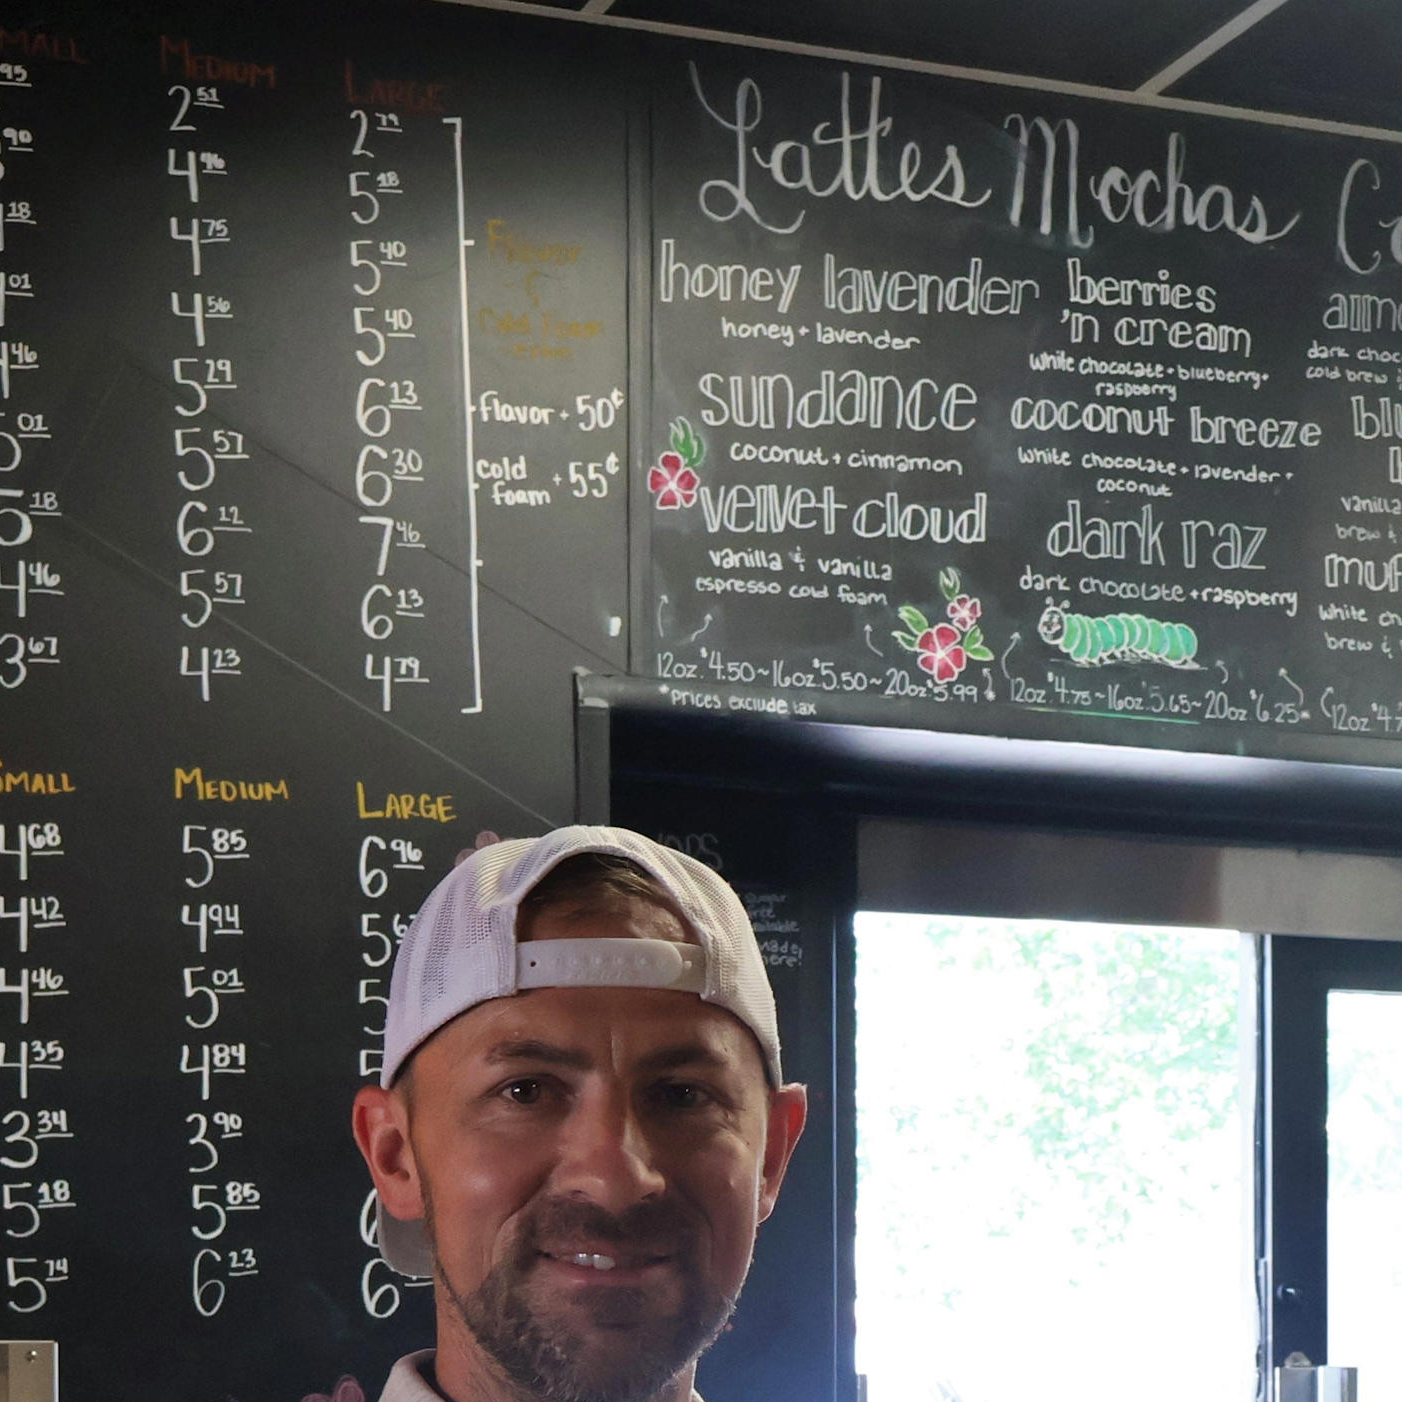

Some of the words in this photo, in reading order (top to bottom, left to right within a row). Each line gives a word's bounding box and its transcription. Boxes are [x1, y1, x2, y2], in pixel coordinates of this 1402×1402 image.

[688, 60, 992, 234] Lattes
[1004, 113, 1300, 249] Mochas
[660, 238, 802, 313] honey
[824, 252, 1040, 315] lavender
[1067, 258, 1217, 314] berries
[721, 316, 794, 347] honey
[816, 320, 921, 351] lavender
[1114, 316, 1252, 358] cream
[1029, 351, 1075, 371] white
[1079, 356, 1164, 379] chocolate
[699, 370, 977, 431] sundance
[1096, 381, 1177, 402] raspberry
[1010, 397, 1176, 436] coconut
[1190, 406, 1322, 448] breeze
[476, 455, 527, 480] cold
[730, 442, 828, 466] coconut
[848, 449, 963, 476] cinnamon
[1018, 446, 1072, 466] white
[1082, 453, 1177, 476] chocolate
[1194, 465, 1281, 483] lavender
[492, 481, 551, 506] foam
[1097, 479, 1173, 498] coconut
[699, 484, 848, 535] velvet
[853, 492, 987, 544] cloud
[1047, 500, 1166, 566] dark
[1181, 520, 1268, 570] raz
[709, 548, 783, 570] vanilla
[817, 557, 892, 581] vanilla
[696, 578, 781, 595] espresso
[837, 585, 887, 605] foam
[1019, 564, 1071, 591] dark
[1079, 576, 1187, 602] chocolate
[1318, 605, 1368, 624] white
[1324, 632, 1373, 652] brew
